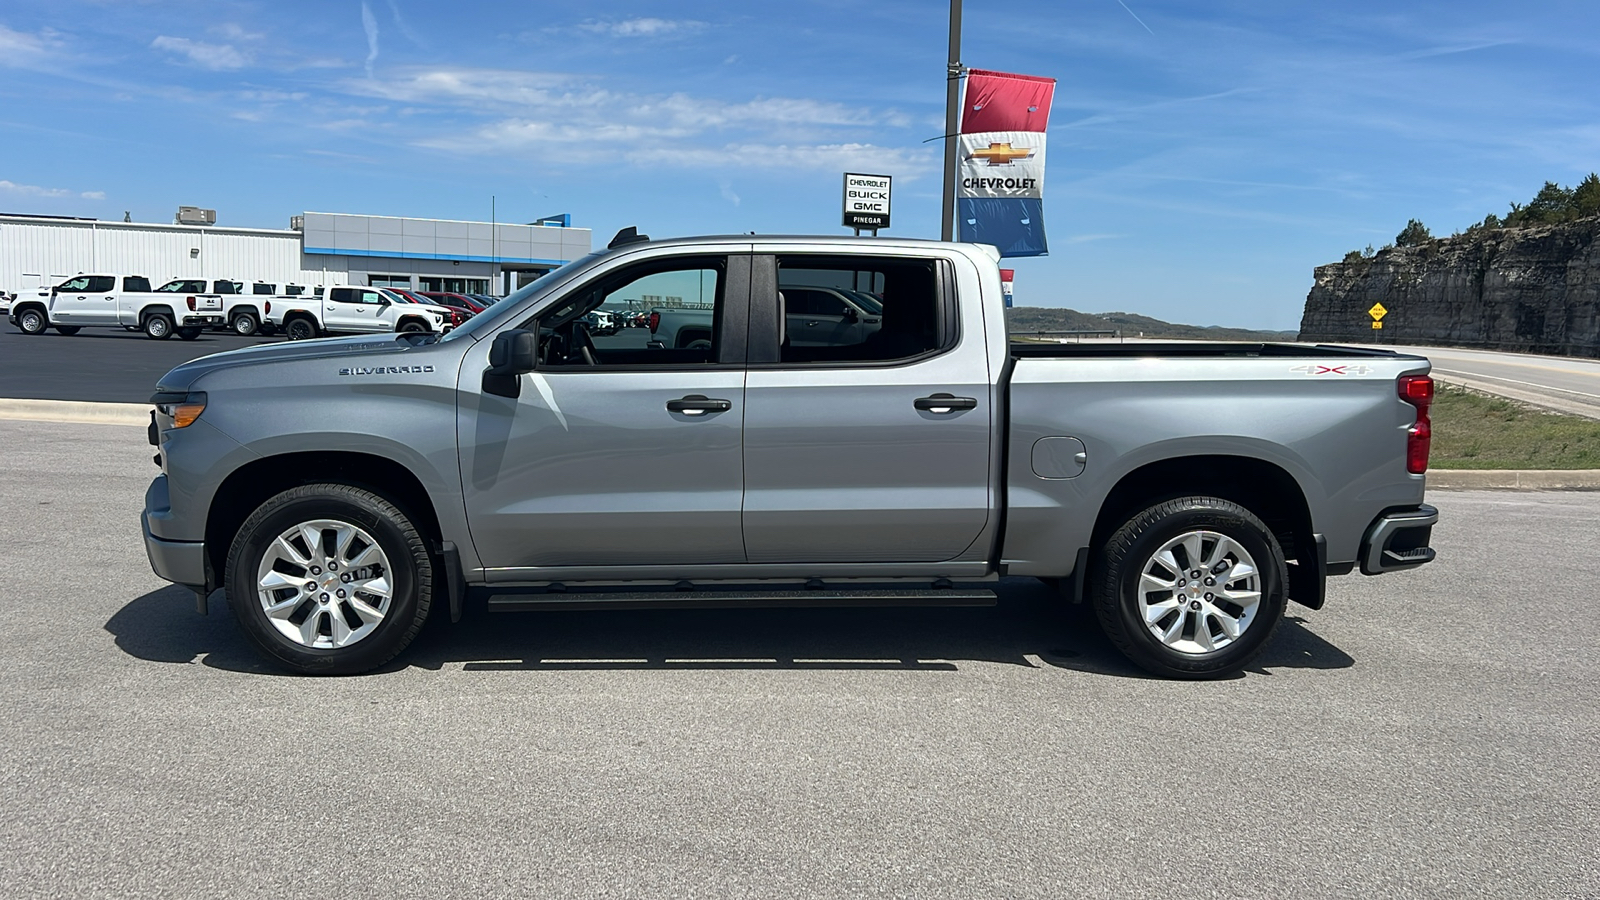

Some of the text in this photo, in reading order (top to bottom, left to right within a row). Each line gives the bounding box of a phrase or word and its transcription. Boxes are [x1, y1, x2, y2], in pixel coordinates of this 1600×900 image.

[850, 179, 887, 188] CHEVROLET
[963, 178, 1036, 189] CHEVROLET
[849, 190, 887, 200] BUICK
[853, 202, 882, 211] GMC
[853, 216, 882, 224] PINEGAR
[338, 365, 435, 376] SILVERADO
